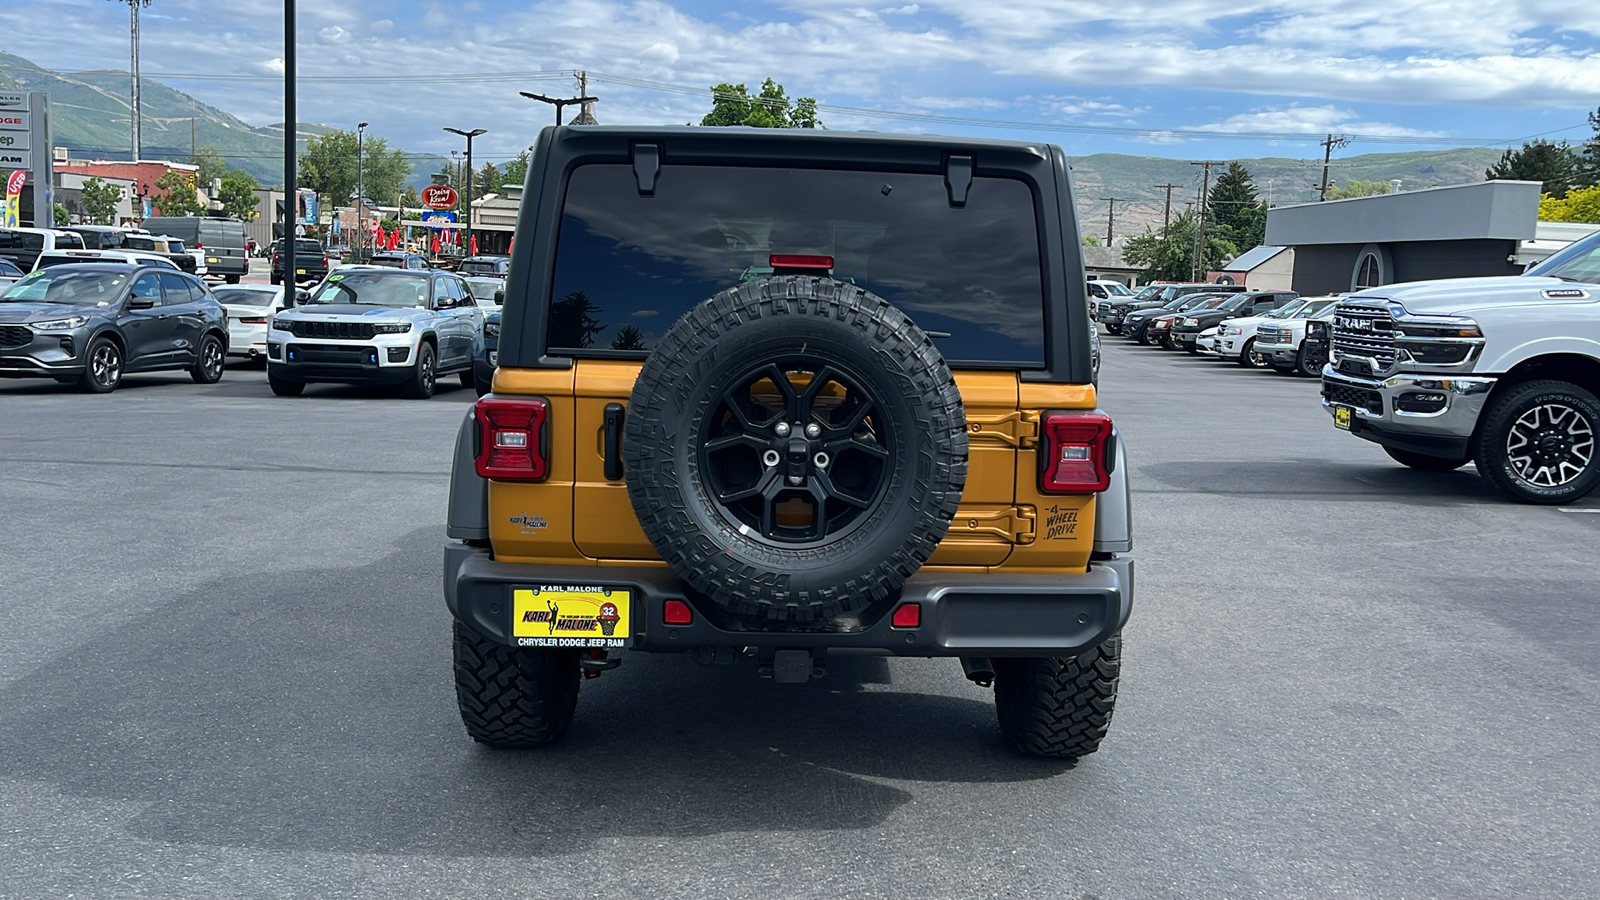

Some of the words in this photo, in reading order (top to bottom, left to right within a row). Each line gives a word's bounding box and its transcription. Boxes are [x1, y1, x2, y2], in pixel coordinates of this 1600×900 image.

[10, 173, 26, 193] USED
[428, 188, 450, 201] Dairy
[430, 195, 447, 204] Keen
[1050, 504, 1058, 514] 4
[1046, 512, 1078, 527] WHEEL
[1046, 523, 1078, 540] DRIVE
[540, 585, 565, 593] KARL
[522, 611, 551, 622] KARL
[602, 607, 615, 616] 32
[555, 619, 599, 631] MALONE
[518, 638, 558, 646] CHRYSLER
[587, 639, 606, 647] JEEP
[607, 639, 625, 647] RAM
